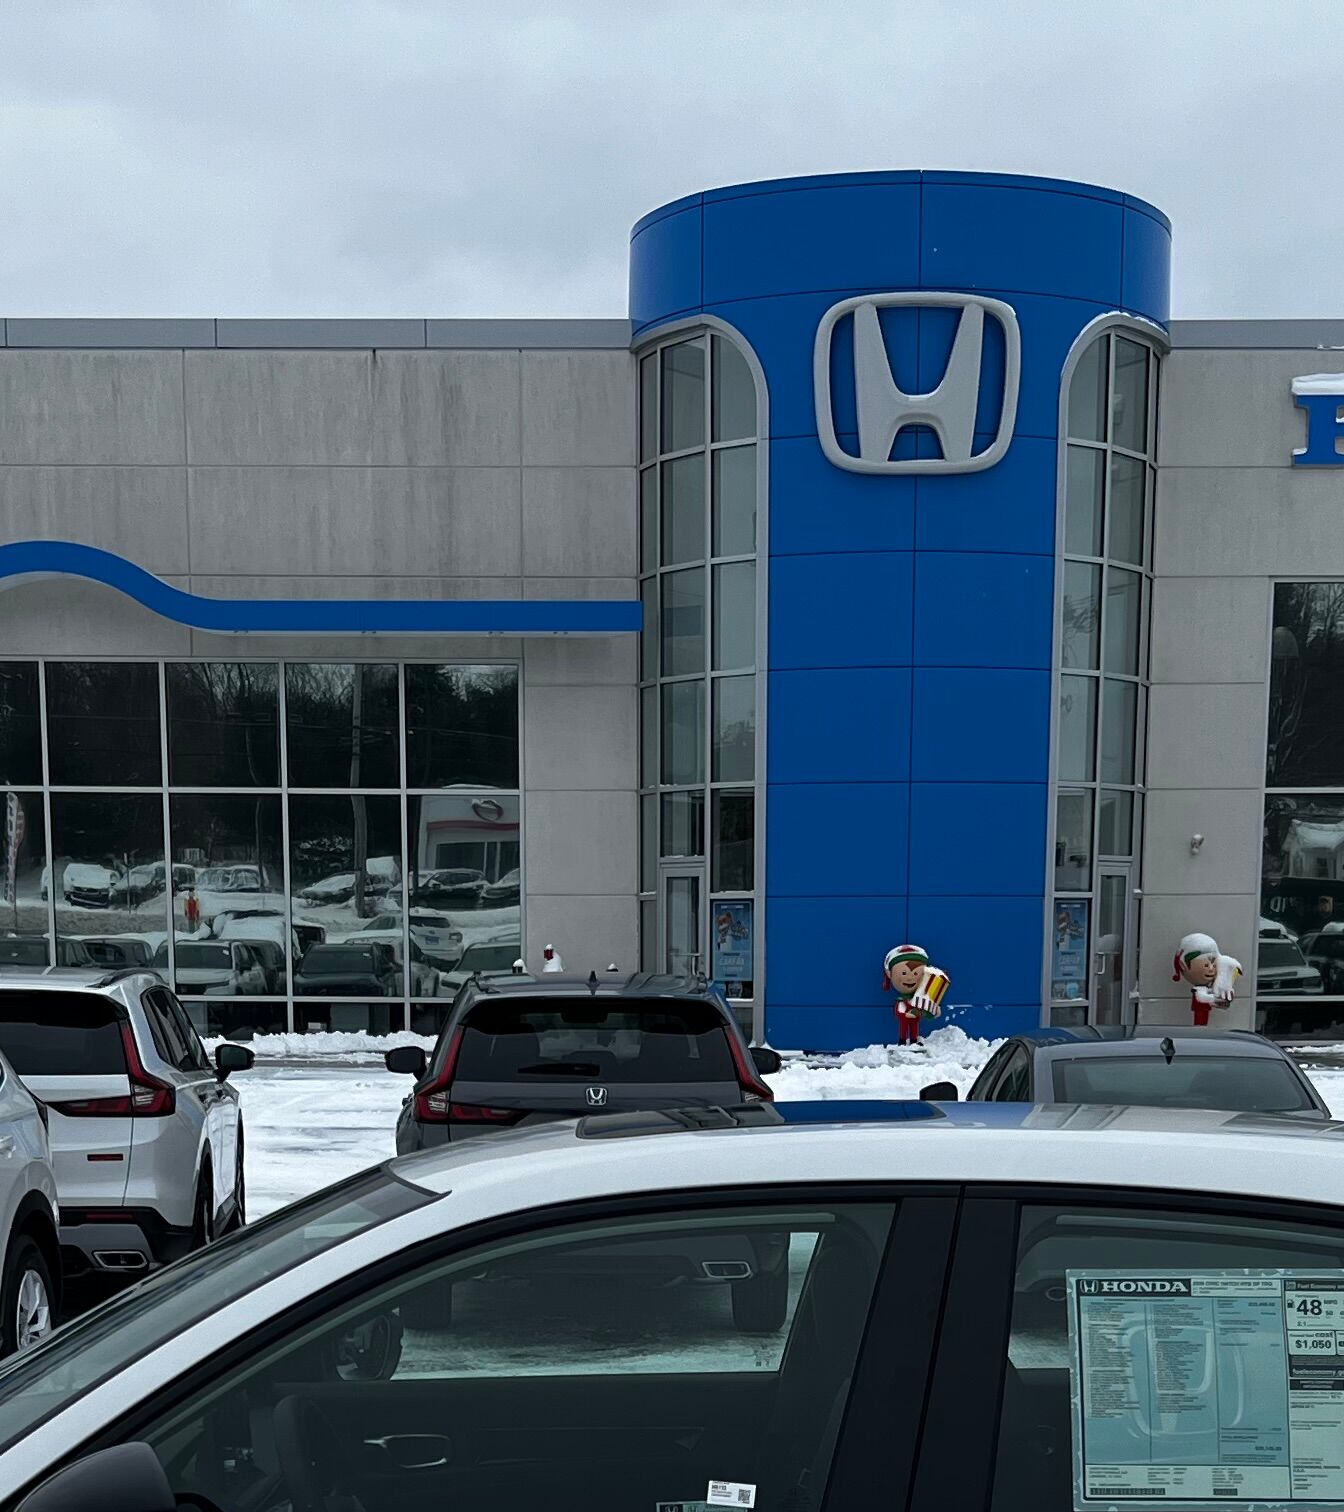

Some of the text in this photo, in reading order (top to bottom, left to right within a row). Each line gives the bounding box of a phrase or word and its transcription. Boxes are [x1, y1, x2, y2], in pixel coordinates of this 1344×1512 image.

[1102, 1281, 1189, 1293] HONDA
[1296, 1299, 1323, 1316] 48
[1295, 1340, 1332, 1350] $1,050
